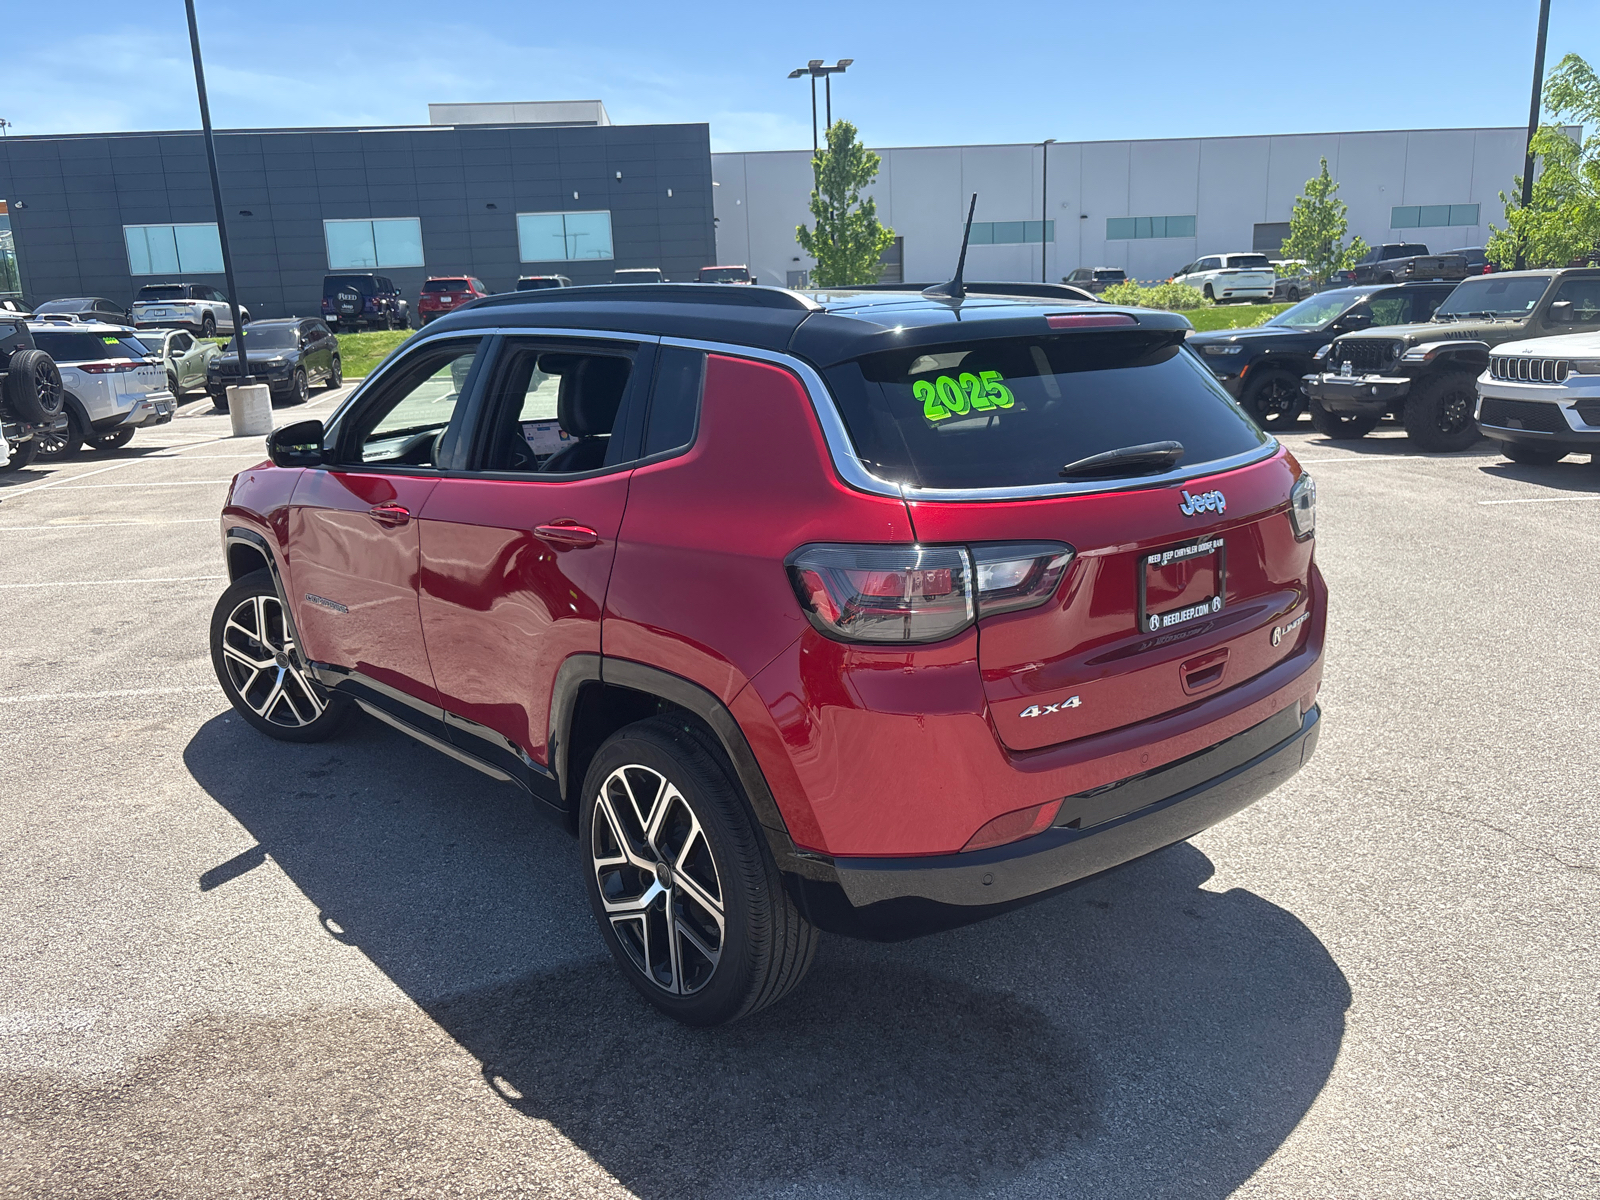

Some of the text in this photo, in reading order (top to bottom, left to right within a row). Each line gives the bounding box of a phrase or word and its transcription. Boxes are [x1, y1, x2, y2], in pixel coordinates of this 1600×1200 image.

[338, 293, 357, 301] REED
[1443, 330, 1479, 339] WILLYS
[912, 370, 1015, 422] 2025
[1179, 490, 1226, 517] Jeep
[1147, 538, 1224, 565] REED JEEP CHRYSLER DODGE RAM
[1163, 603, 1209, 627] REEDJEEP.COM
[1019, 695, 1083, 718] 4x4
